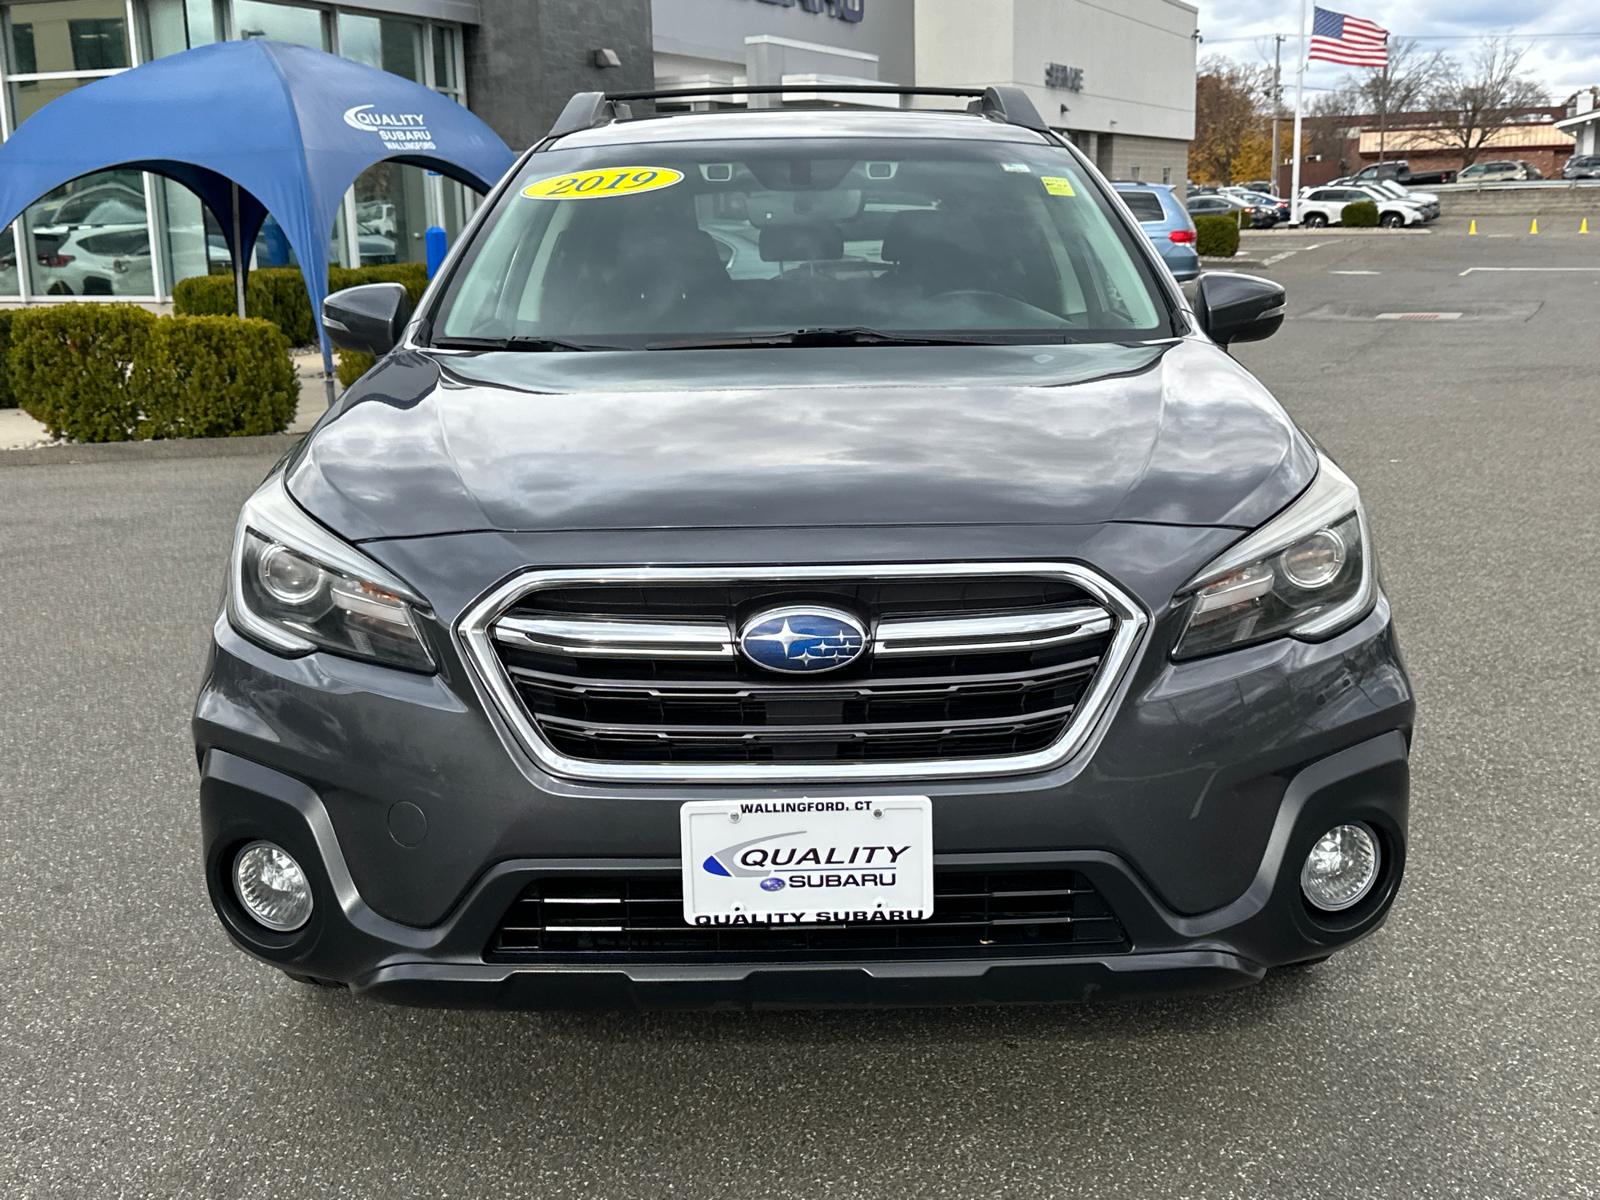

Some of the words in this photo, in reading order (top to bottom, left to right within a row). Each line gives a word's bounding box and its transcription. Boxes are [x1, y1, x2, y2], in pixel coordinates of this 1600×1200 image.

[357, 112, 424, 126] QUALITY
[379, 130, 432, 141] SUBARU
[383, 141, 437, 150] WALLINGFORD
[546, 171, 658, 195] 2019
[855, 801, 873, 811] CT
[740, 846, 912, 867] QUALITY
[788, 873, 896, 888] SUBARU
[694, 911, 806, 926] QUALITY
[815, 909, 924, 923] SUBARU
